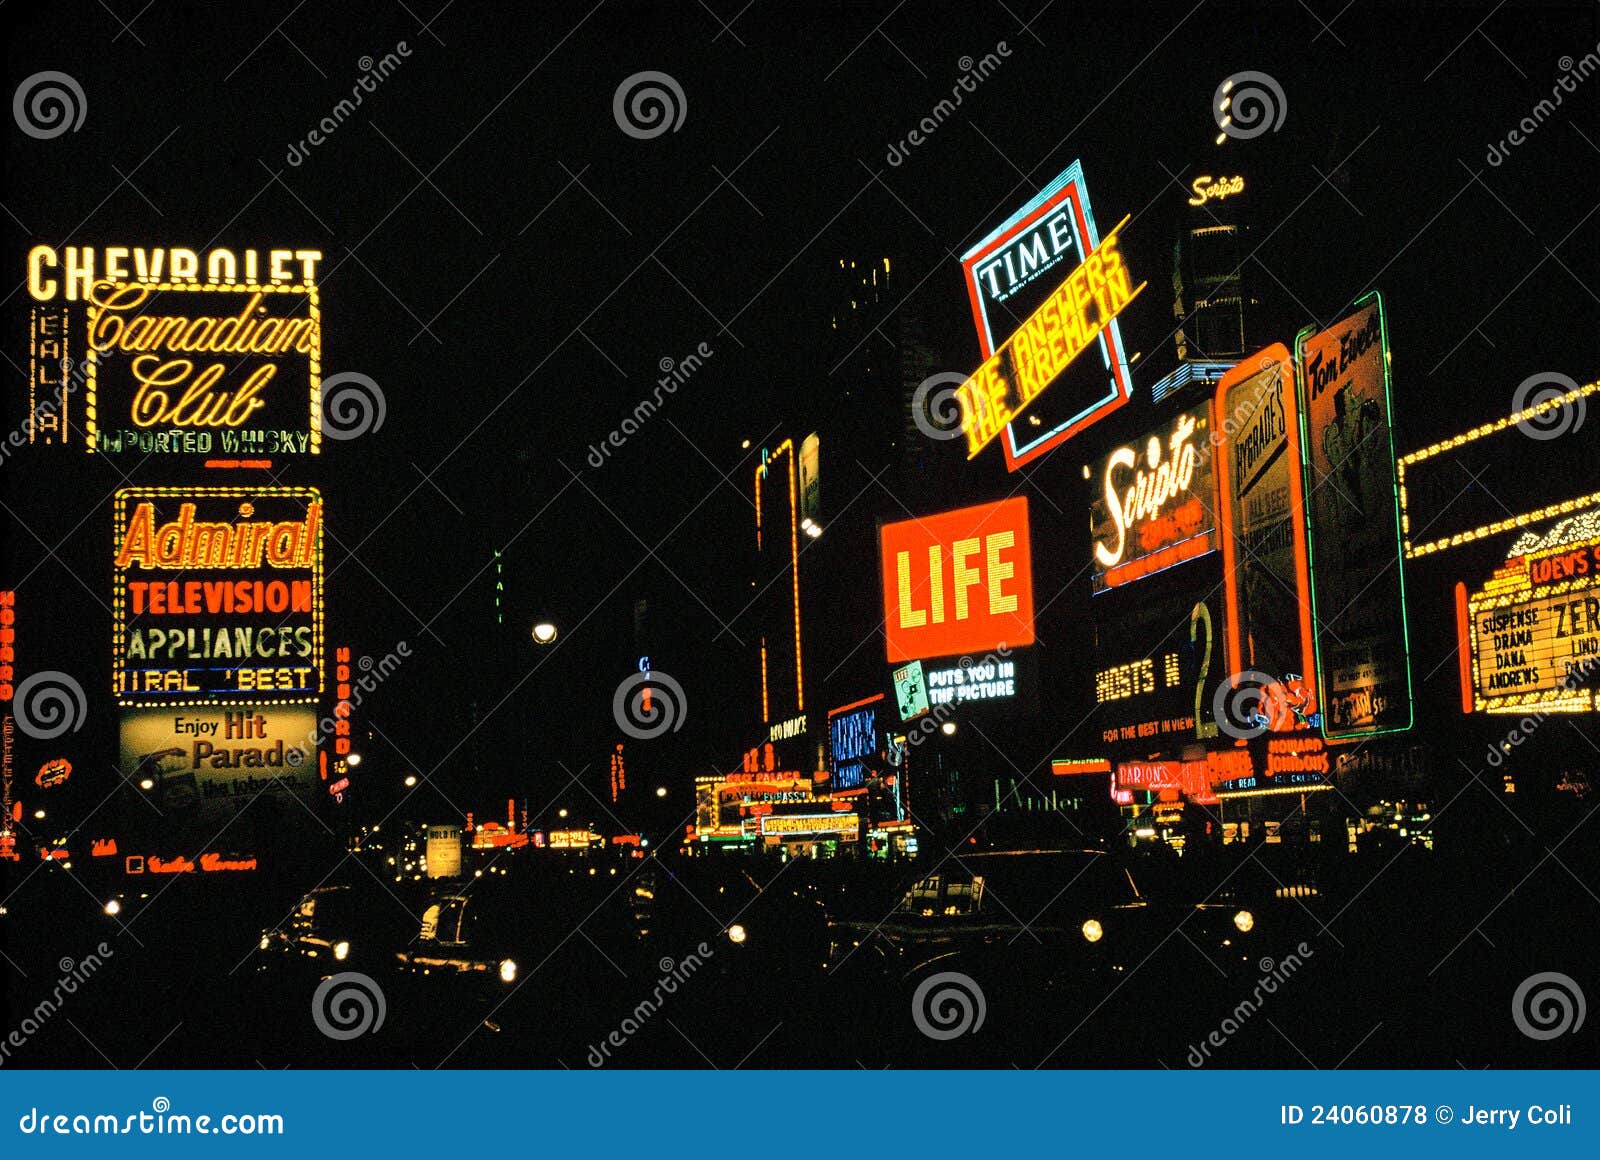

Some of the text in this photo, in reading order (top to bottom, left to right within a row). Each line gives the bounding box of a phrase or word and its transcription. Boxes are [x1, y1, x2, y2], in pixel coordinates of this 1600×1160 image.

[1189, 175, 1245, 206] Scripto
[980, 212, 1074, 299] TIME
[87, 279, 317, 353] Canadian
[1013, 236, 1120, 371] ANSWERS
[1017, 263, 1132, 402] KREMLIN
[130, 354, 278, 427] Club
[1096, 414, 1196, 567] Scripto
[115, 502, 321, 569] Admiral
[897, 530, 1018, 629] LIFE
[129, 581, 312, 614] TELEVISION
[1482, 608, 1540, 635] SUSPENSE
[127, 626, 312, 659] APPLIANCES
[1494, 629, 1533, 652] DRAMA
[929, 659, 1014, 687] PUTS YOU IN
[1496, 651, 1527, 672] DANA
[957, 680, 1015, 702] PICTURE
[1488, 667, 1540, 690] ANDREWS
[174, 711, 267, 740] Enjoy Hit
[1103, 729, 1119, 743] FOR
